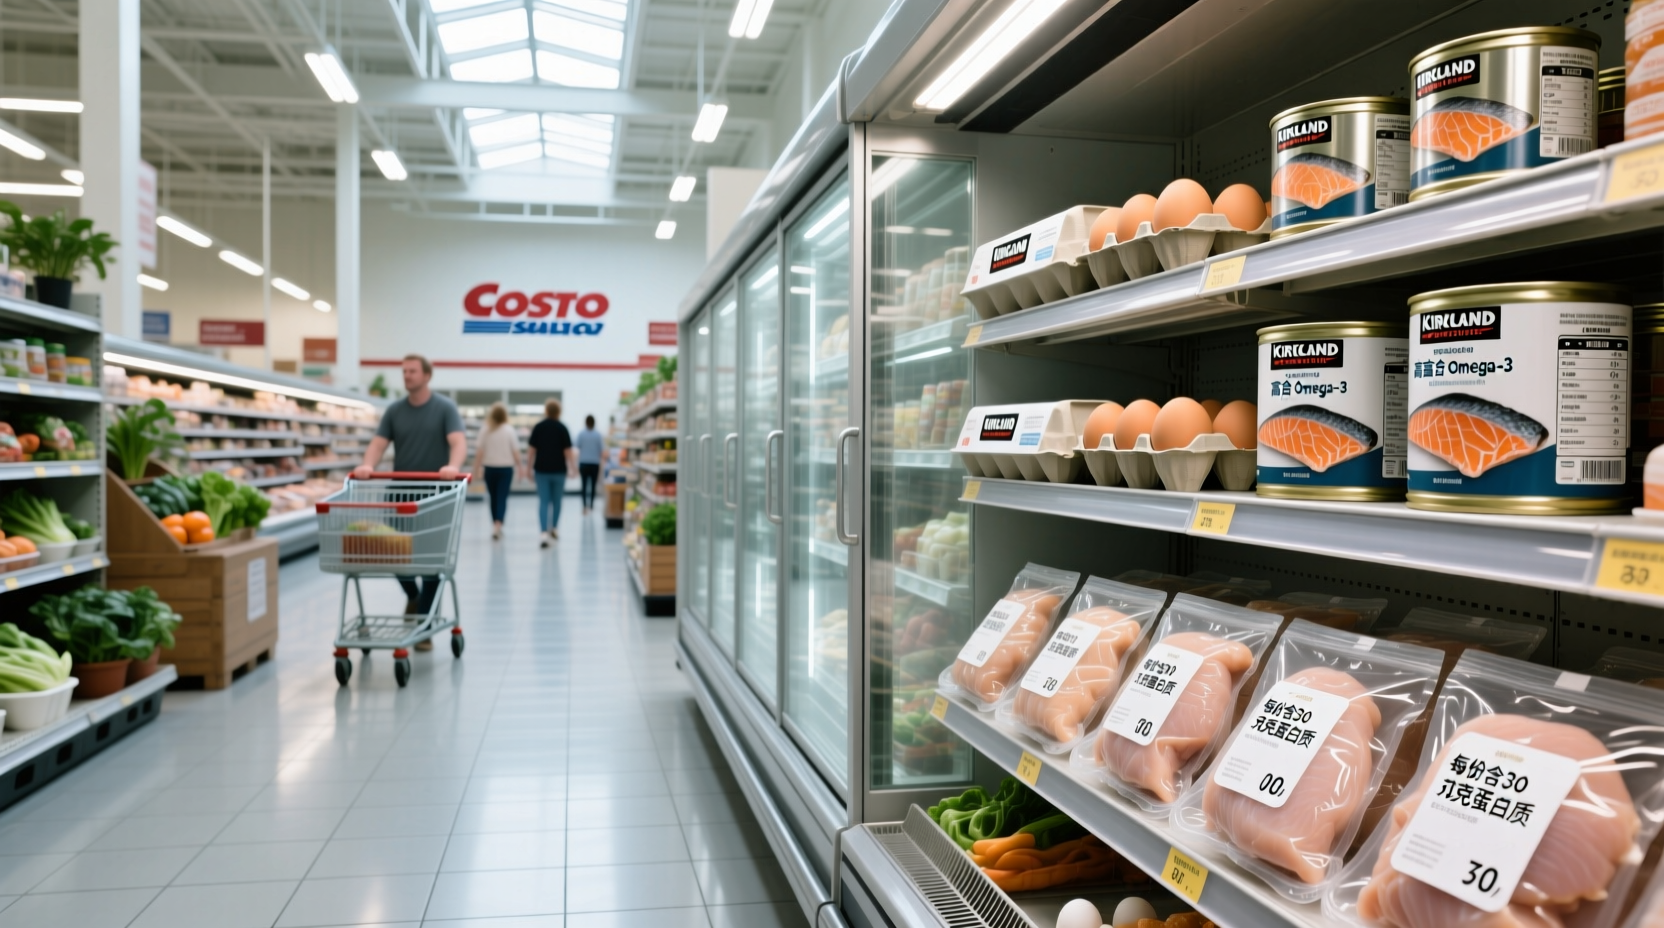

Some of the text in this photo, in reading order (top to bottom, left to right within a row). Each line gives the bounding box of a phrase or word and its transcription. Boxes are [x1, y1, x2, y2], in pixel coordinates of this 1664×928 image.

[1422, 310, 1496, 332] KIRKLAND
[1448, 357, 1513, 376] Omega-3
[1294, 380, 1347, 398] Omega-3
